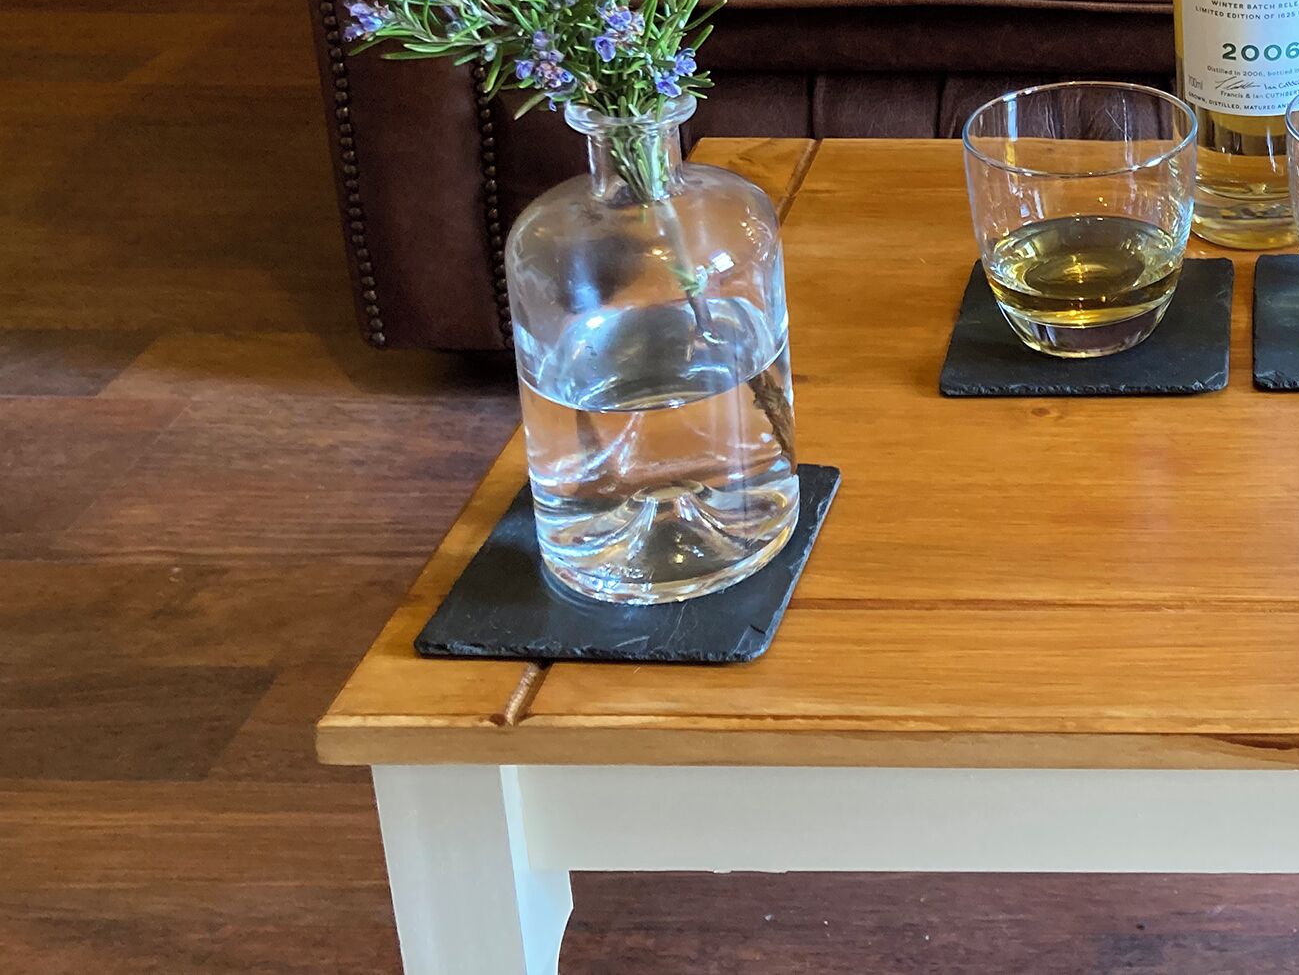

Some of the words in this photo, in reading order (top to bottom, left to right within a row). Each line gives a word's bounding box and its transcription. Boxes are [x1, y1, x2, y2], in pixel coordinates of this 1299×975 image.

[1211, 0, 1244, 10] WINTER
[1247, 2, 1276, 10] BATCH
[1195, 6, 1225, 17] LIMITED
[1227, 11, 1261, 20] EDITION
[1264, 11, 1275, 20] OF
[1207, 65, 1233, 76] Distilled
[1220, 90, 1244, 99] Francis
[1244, 103, 1276, 111] MATURED
